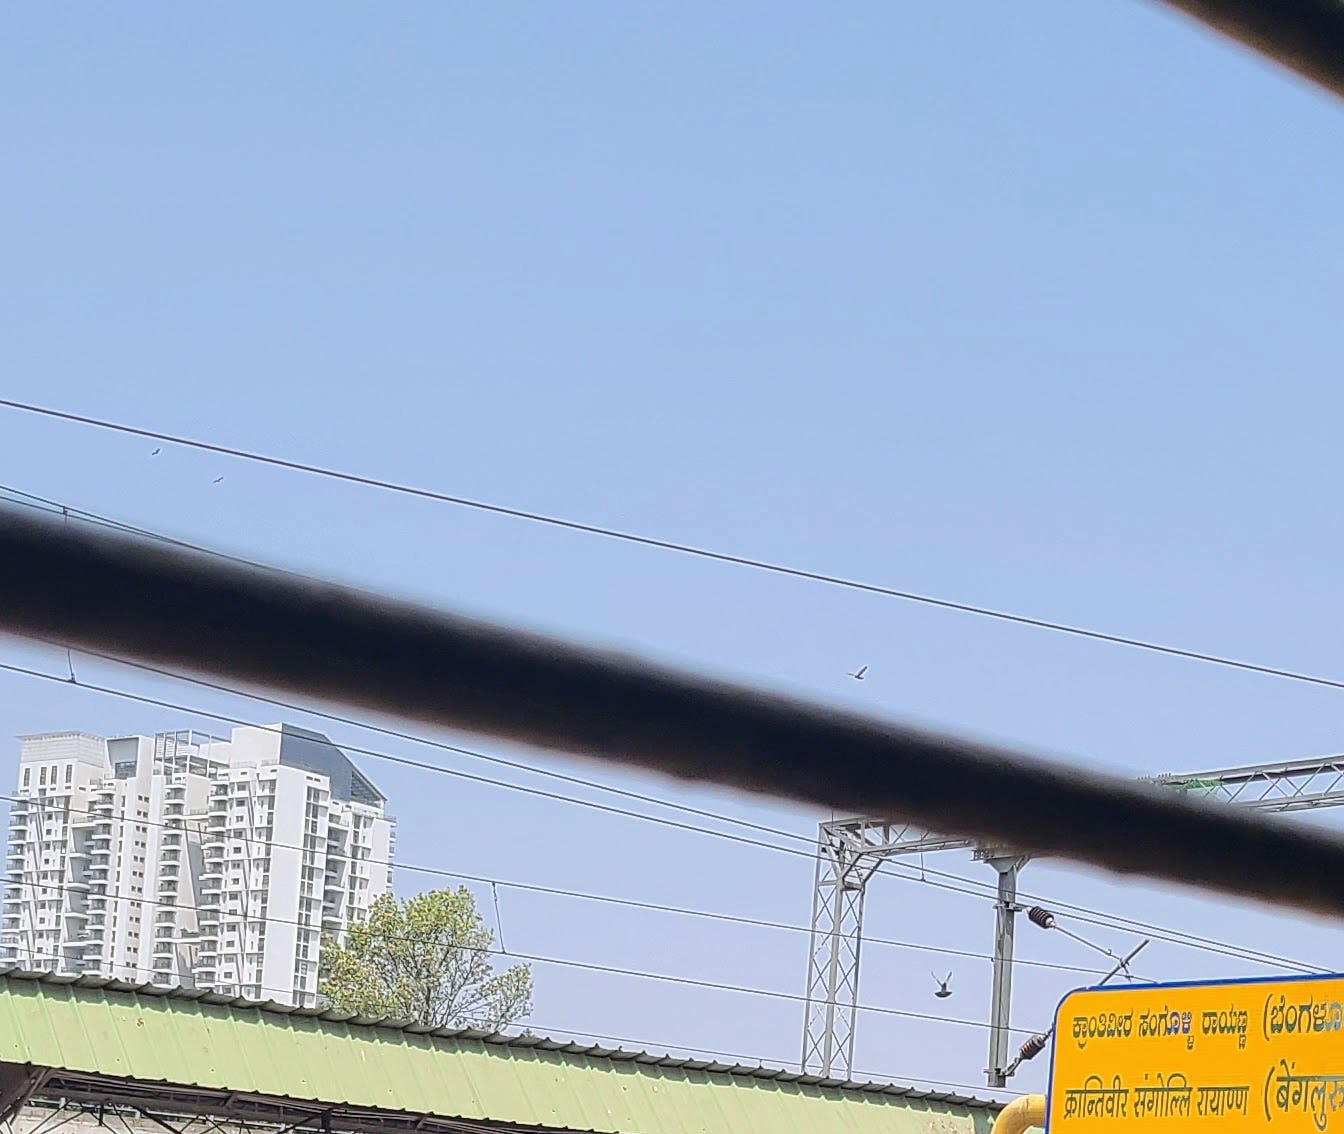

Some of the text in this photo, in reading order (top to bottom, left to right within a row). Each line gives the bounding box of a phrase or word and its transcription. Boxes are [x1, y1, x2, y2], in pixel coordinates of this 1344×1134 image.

[1072, 1008, 1134, 1049] ಕ್ರಾಂತಿವೀರ
[1202, 1003, 1248, 1050] ರಾಯಣ್ಣ
[1063, 1075, 1130, 1119] क्रान्तिवीर
[1134, 1072, 1193, 1118] संगोल्लि
